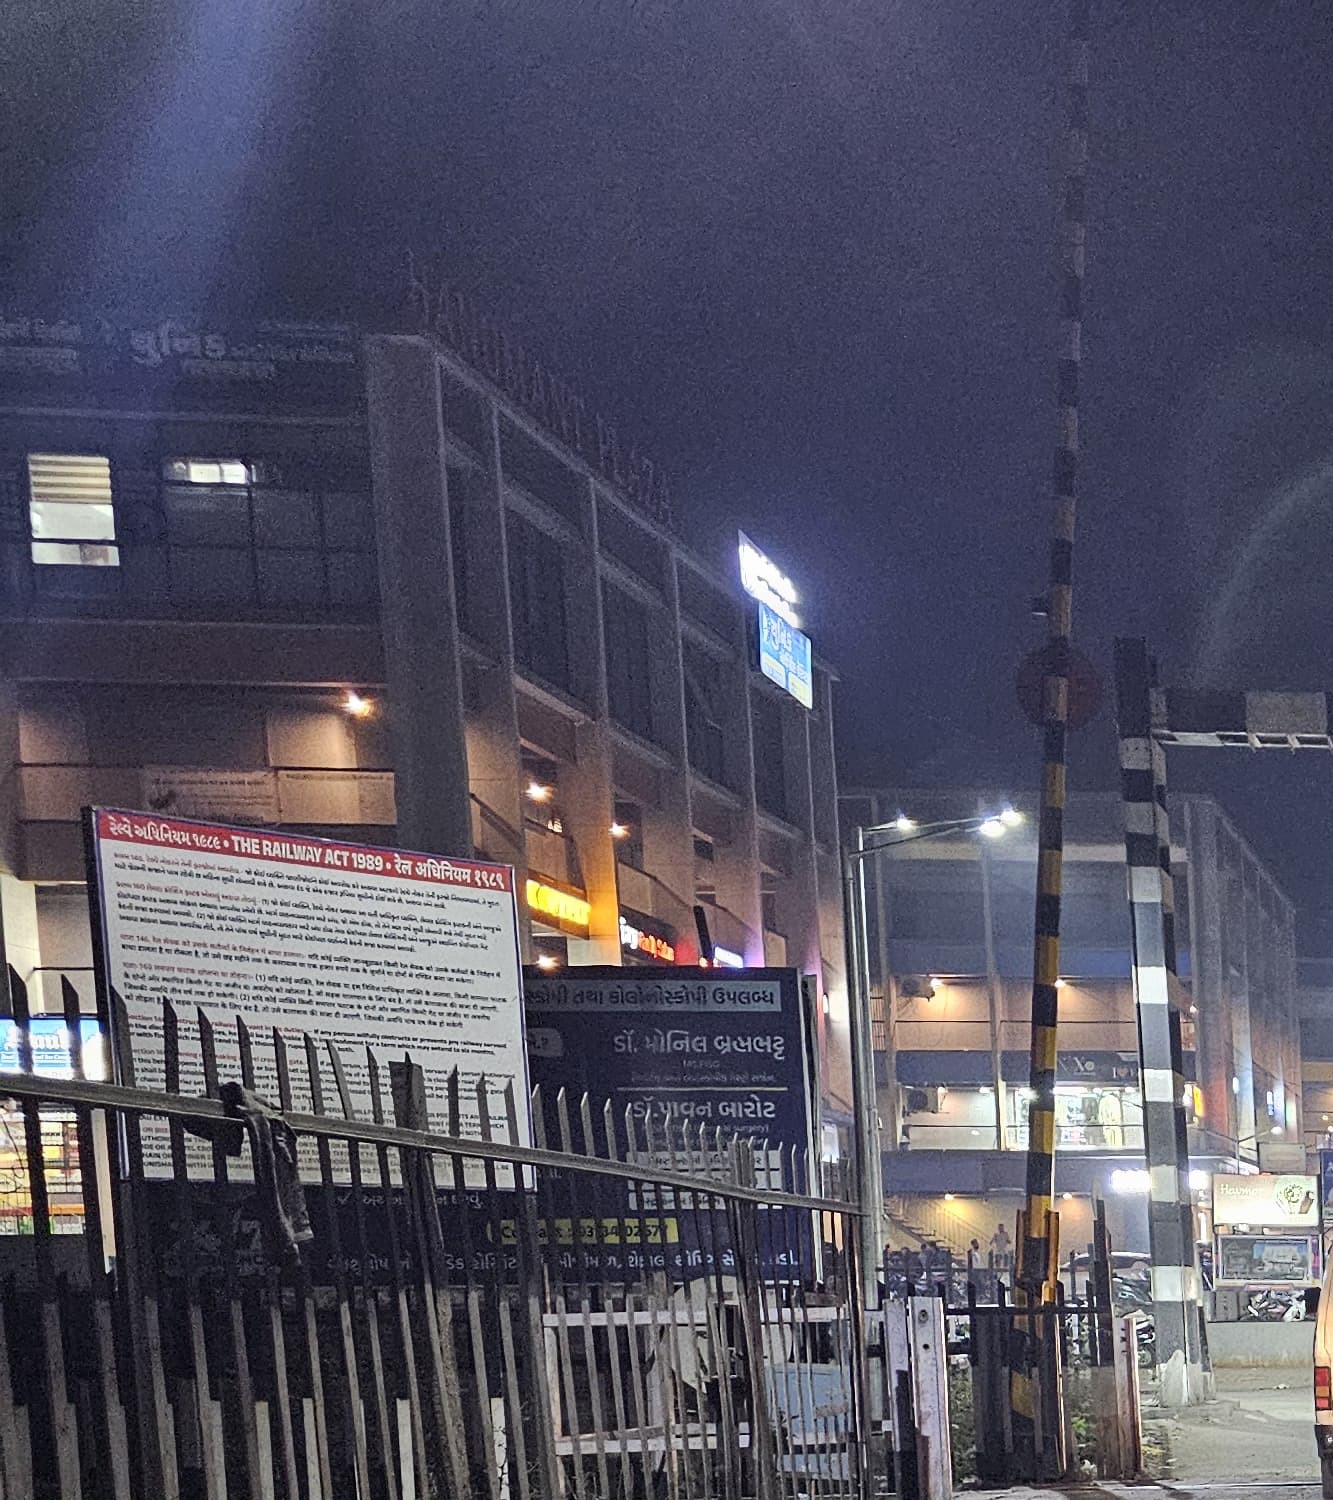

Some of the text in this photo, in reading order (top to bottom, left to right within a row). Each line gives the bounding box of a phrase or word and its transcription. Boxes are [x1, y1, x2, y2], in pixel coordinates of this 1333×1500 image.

[230, 835, 384, 871] THE RAILWAY ACT 1989
[717, 1093, 776, 1119] બારોટ
